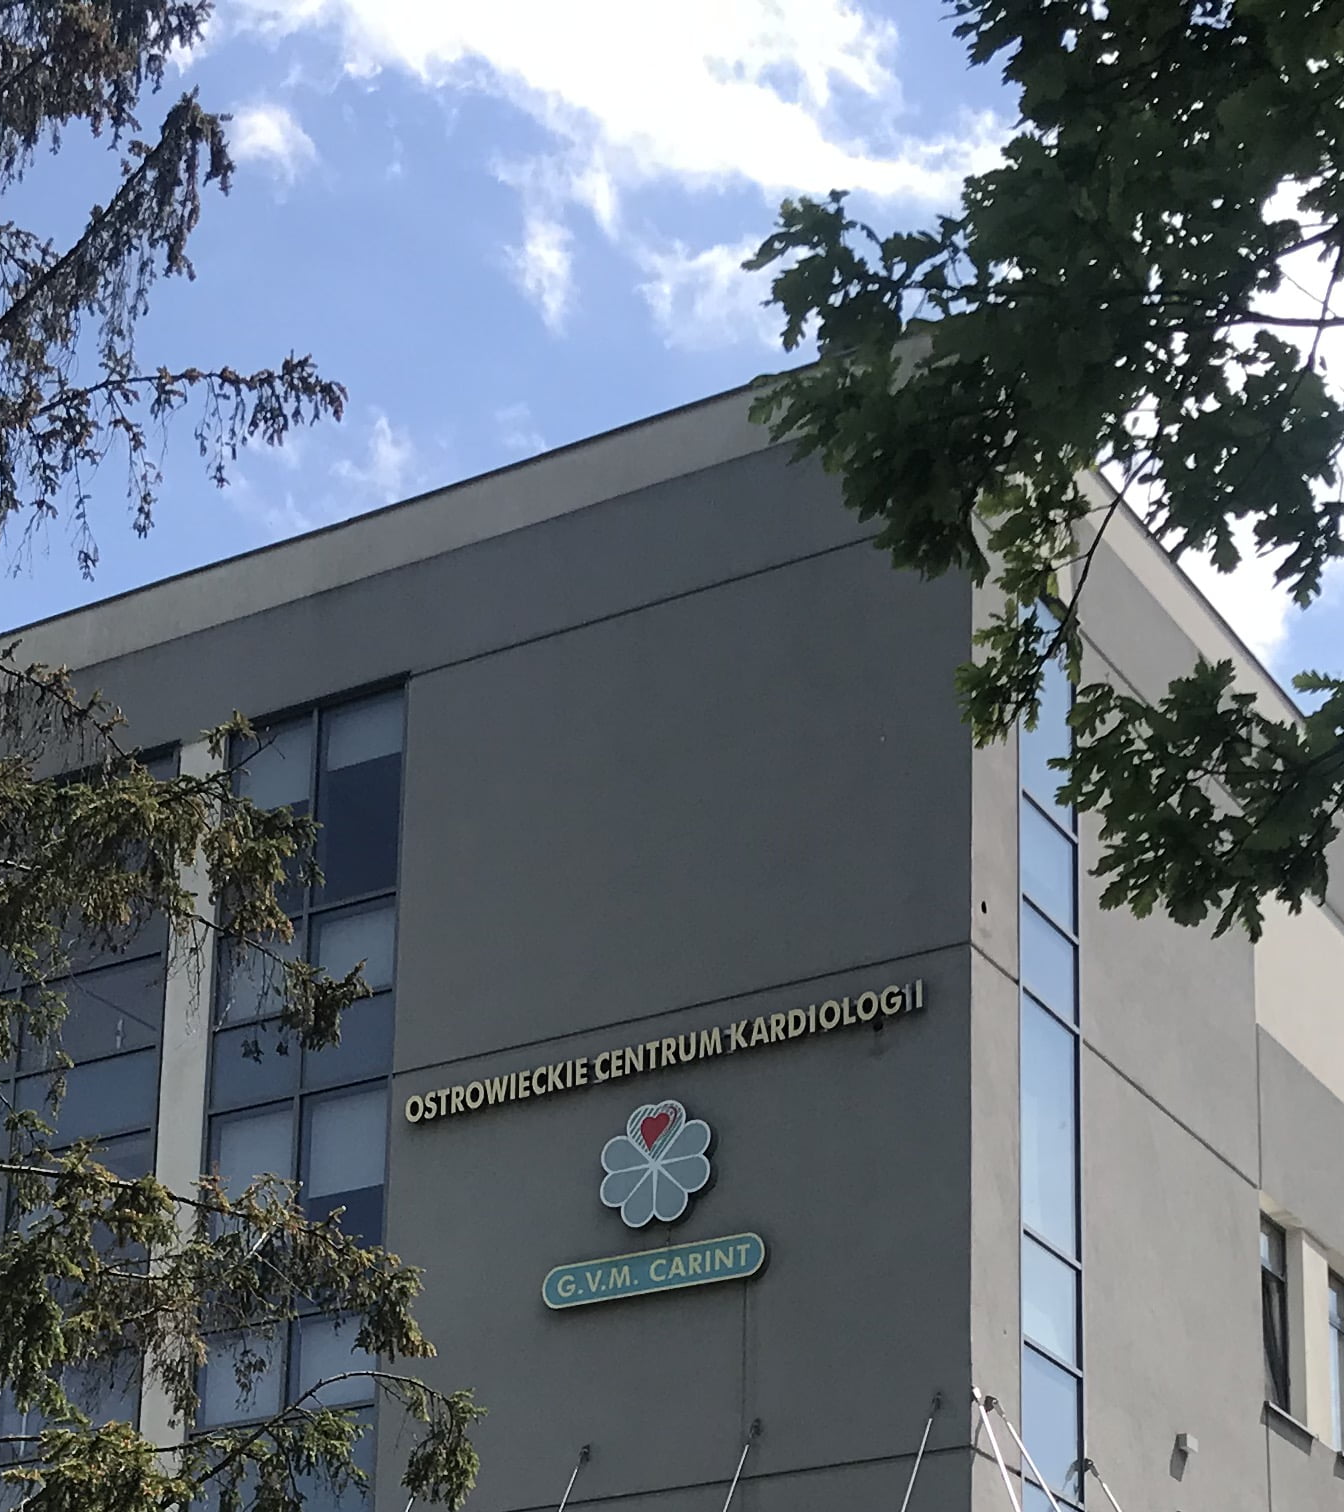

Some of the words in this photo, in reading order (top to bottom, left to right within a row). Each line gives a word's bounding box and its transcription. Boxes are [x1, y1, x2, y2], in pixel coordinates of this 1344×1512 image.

[405, 1057, 588, 1123] OSTROWIECKIE
[595, 1026, 722, 1081] CENTRUM
[730, 978, 923, 1051] KARDIOLOGII
[557, 1265, 639, 1297] G.V.M.
[649, 1243, 751, 1282] CARINT
